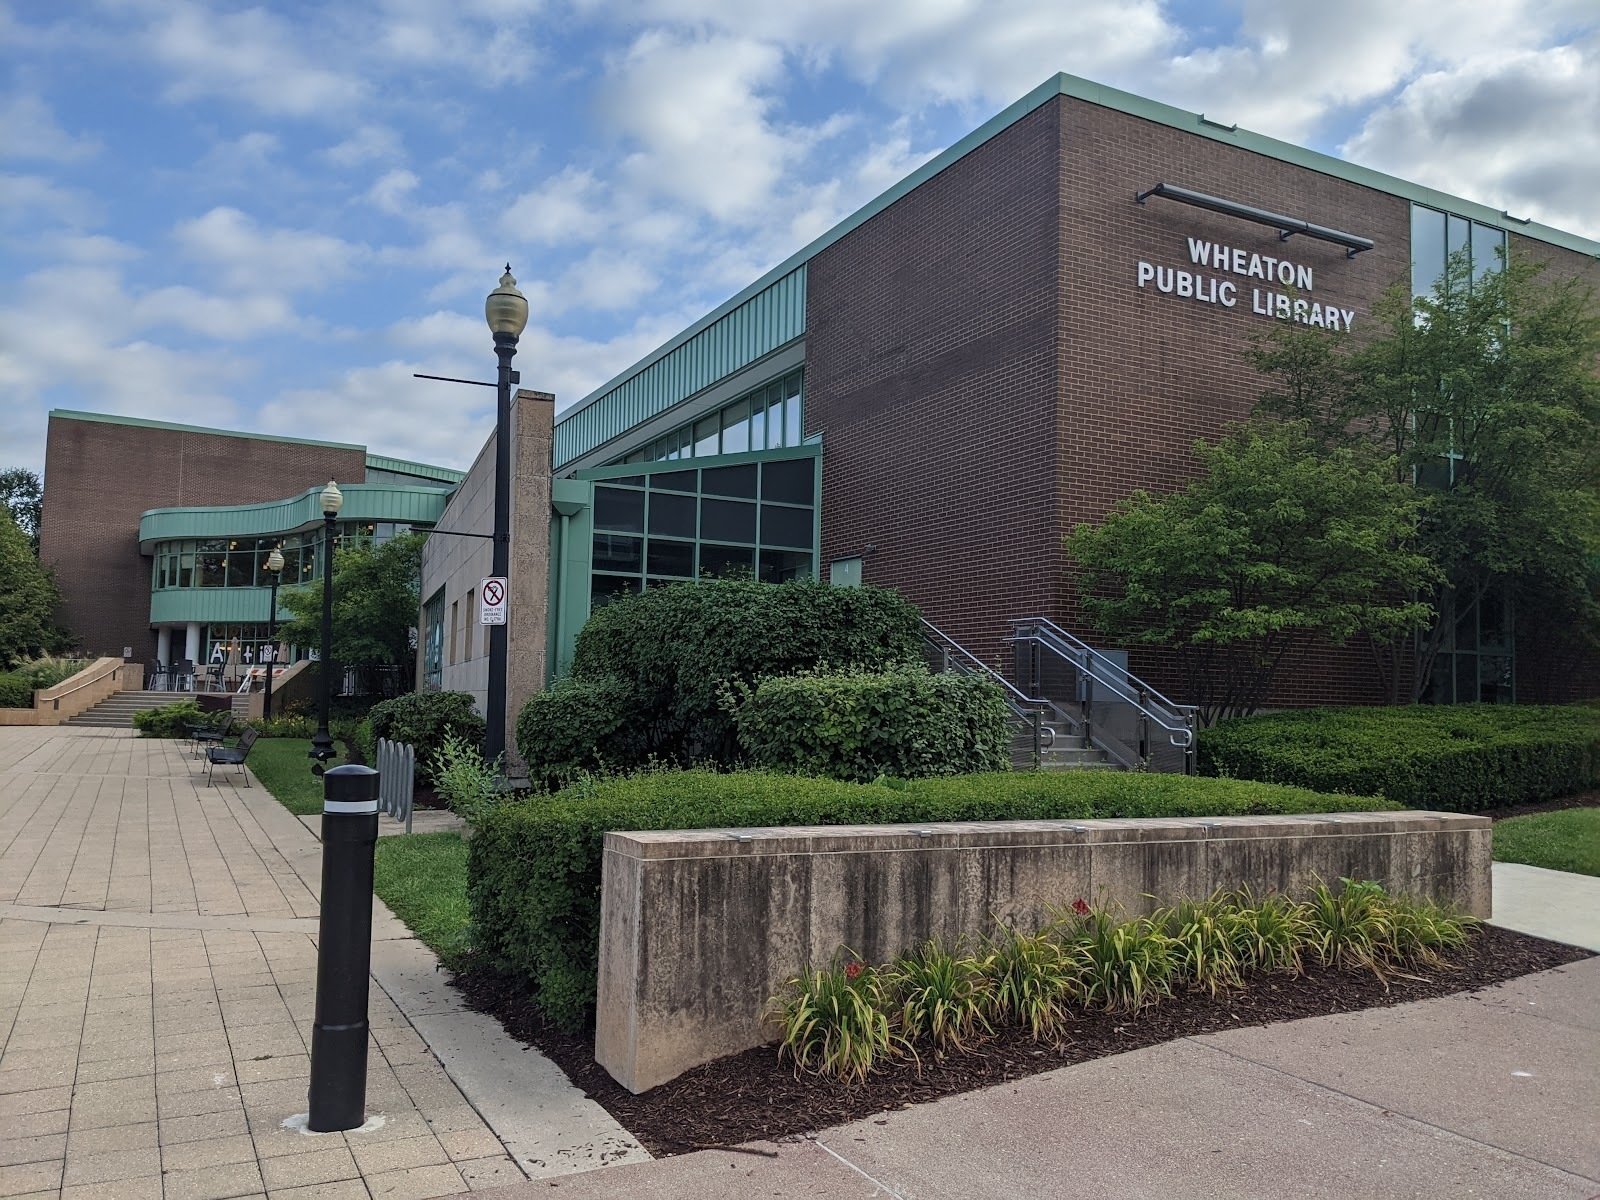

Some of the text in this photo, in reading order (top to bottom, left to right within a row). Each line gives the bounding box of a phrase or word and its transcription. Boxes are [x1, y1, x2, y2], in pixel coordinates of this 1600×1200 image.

[1187, 237, 1313, 291] WHEATON
[1137, 261, 1355, 334] PUBLIC LIBRARY
